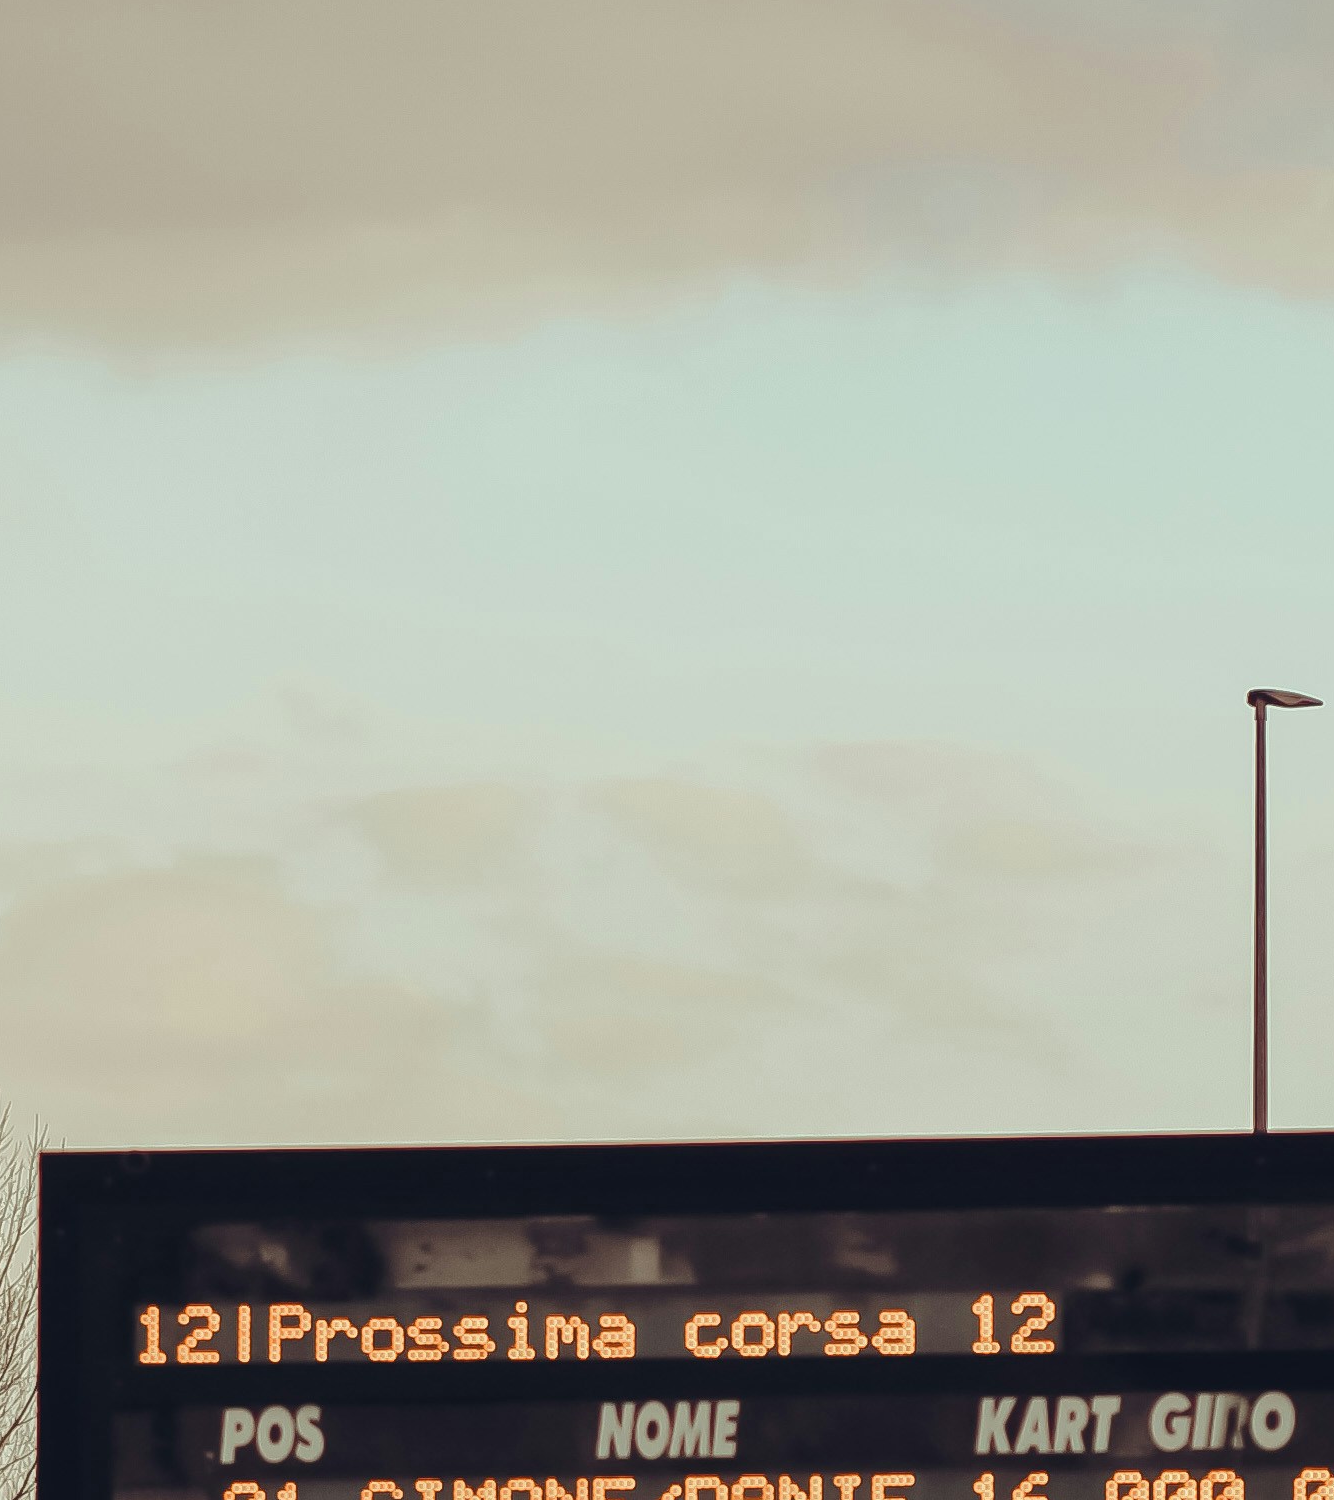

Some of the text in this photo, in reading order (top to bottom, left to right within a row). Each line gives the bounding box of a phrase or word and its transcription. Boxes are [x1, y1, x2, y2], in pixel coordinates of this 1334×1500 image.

[685, 1309, 915, 1358] corsa
[972, 1292, 1055, 1354] 12
[220, 1406, 324, 1464] POS
[596, 1400, 740, 1460] NOME
[976, 1396, 1121, 1454] KART
[1148, 1392, 1295, 1451] GIRO
